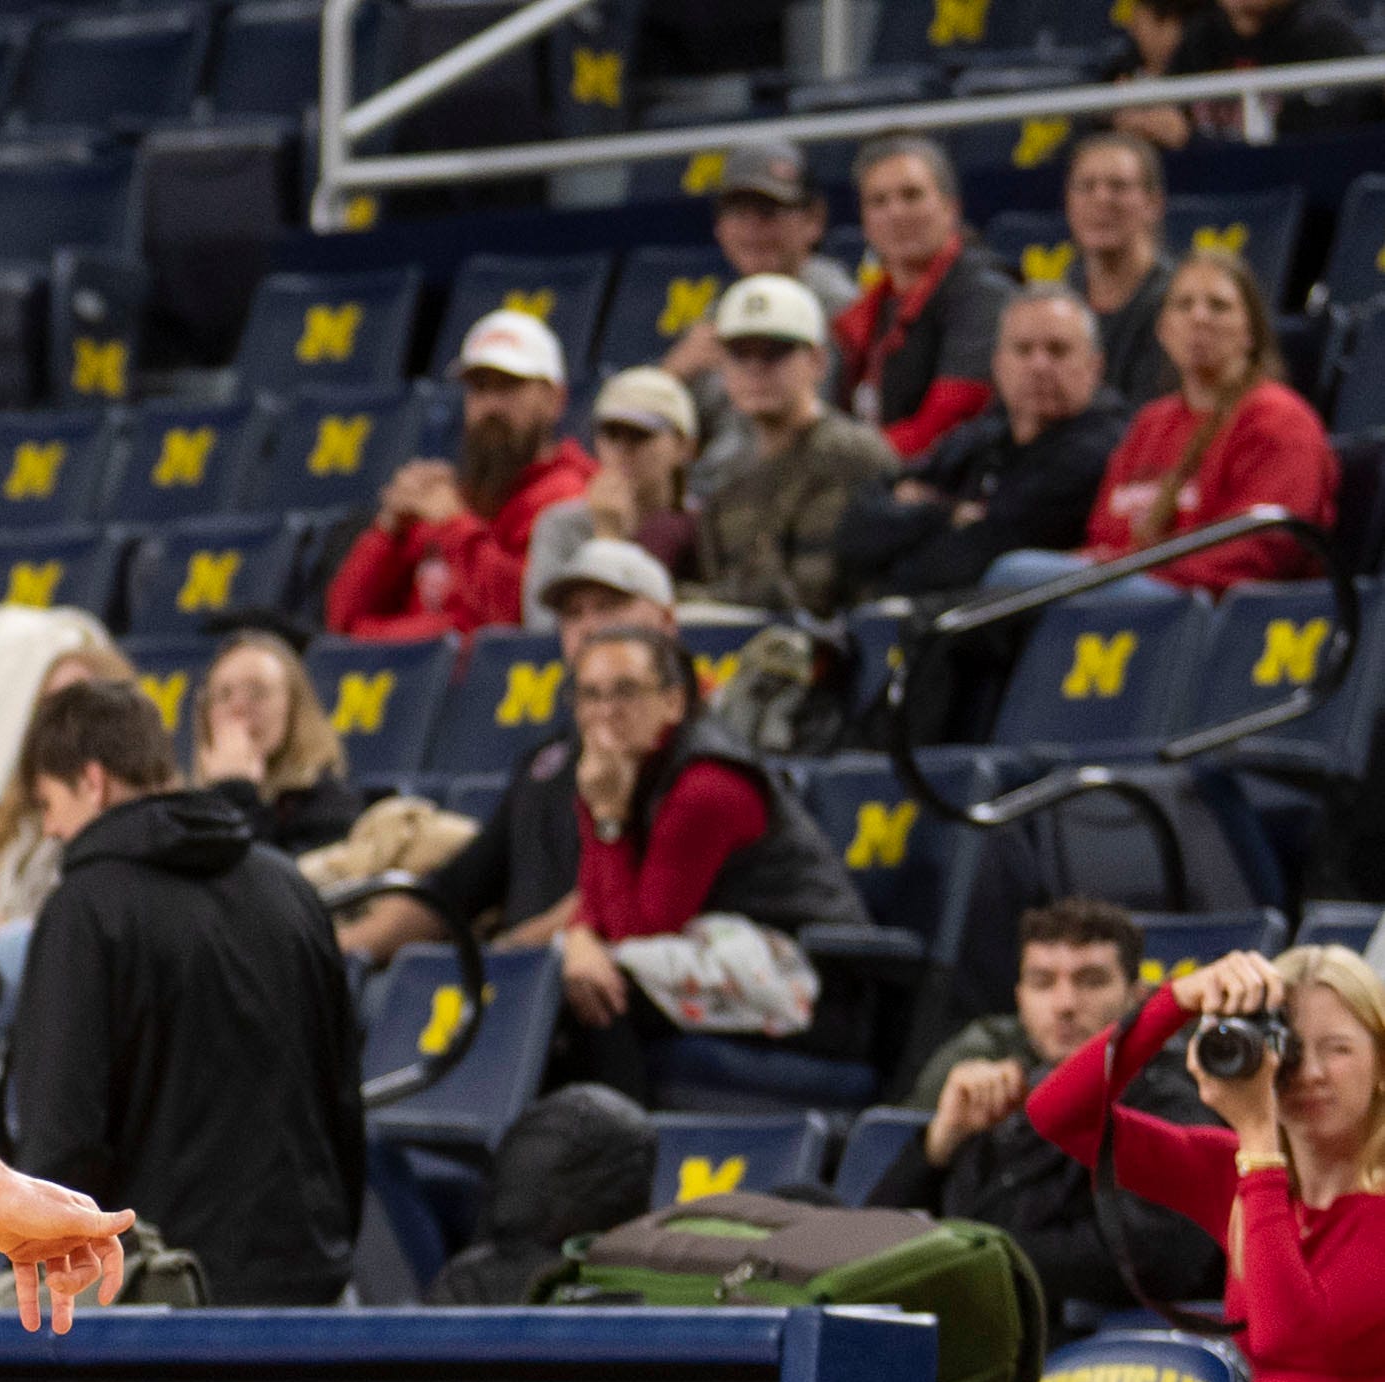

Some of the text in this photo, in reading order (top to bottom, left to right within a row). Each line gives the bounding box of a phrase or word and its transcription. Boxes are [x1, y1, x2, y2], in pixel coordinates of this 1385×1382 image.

[571, 49, 623, 107] M
[295, 302, 363, 363] M
[657, 276, 719, 335] M
[73, 337, 128, 397] M
[2, 441, 67, 500] M
[152, 427, 216, 487] M
[307, 415, 371, 475] M
[5, 560, 63, 610] M
[176, 550, 242, 612] M
[1062, 631, 1138, 699] M
[1251, 617, 1331, 686] M
[330, 670, 396, 735] M
[495, 661, 566, 727] M
[844, 800, 920, 871] M
